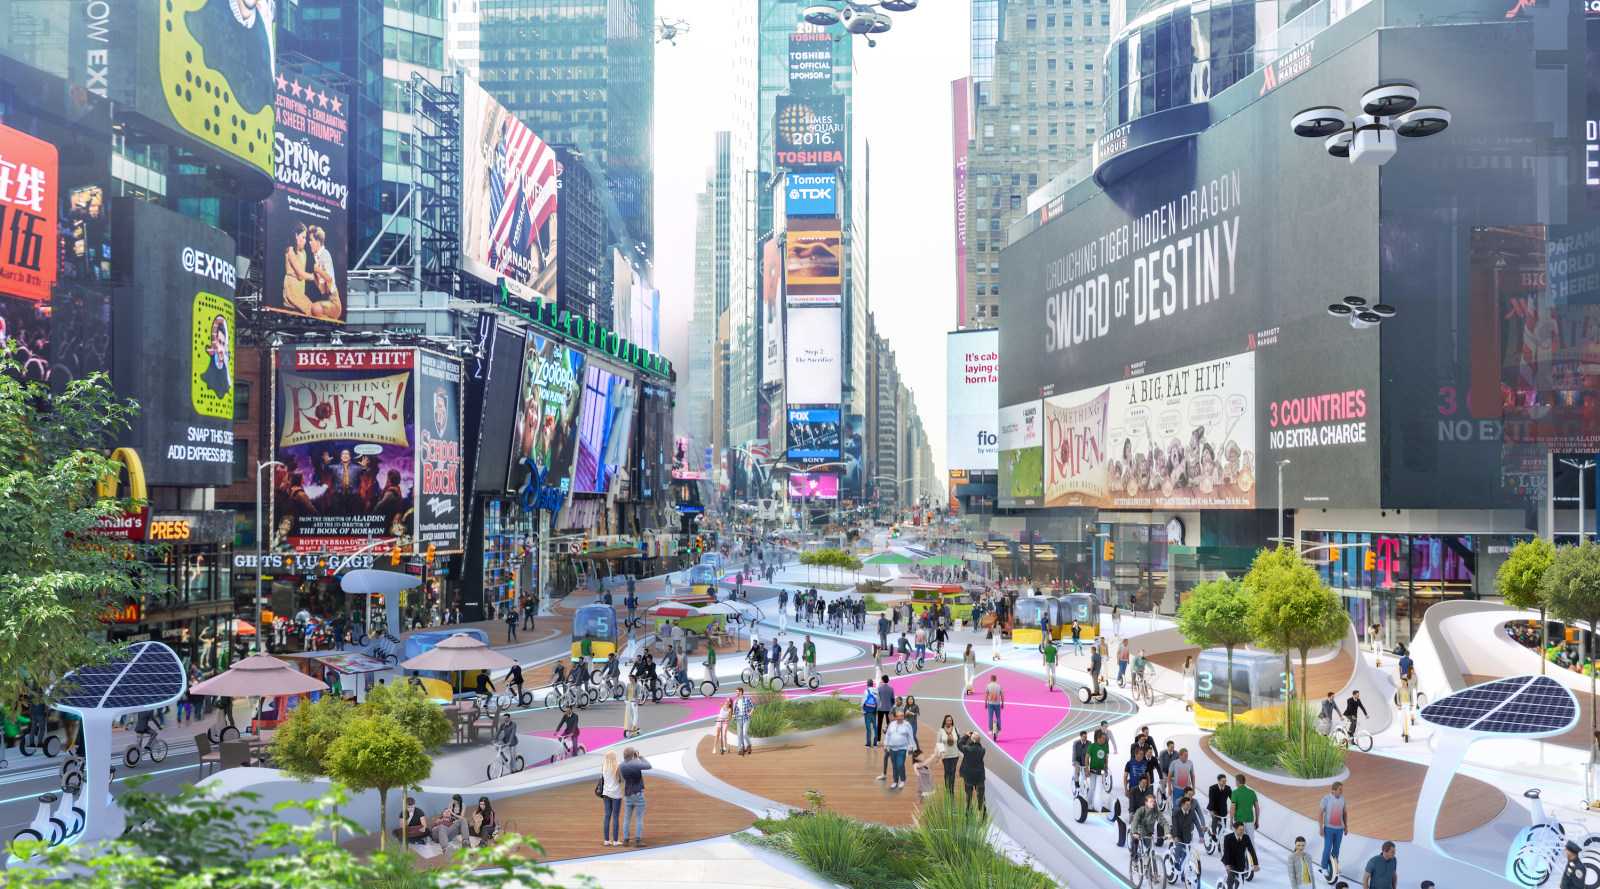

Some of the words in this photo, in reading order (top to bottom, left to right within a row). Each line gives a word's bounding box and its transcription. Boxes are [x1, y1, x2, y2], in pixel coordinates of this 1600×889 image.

[1279, 40, 1314, 67] MARRIOTT
[1278, 54, 1311, 81] MARQUIS
[275, 94, 307, 117] ECTRIFYING
[276, 107, 281, 123] A
[282, 110, 306, 132] SHEER
[803, 116, 832, 124] TIMES
[275, 132, 331, 177] SPRING
[777, 151, 843, 163] TOSHIBA
[798, 188, 832, 199] TDK
[1046, 241, 1097, 292] CROUCHING
[1099, 225, 1129, 267] TIGER
[1133, 201, 1176, 252] HIDDEN
[1181, 168, 1241, 231] DRAGON
[1045, 273, 1110, 353] SWORD
[1114, 277, 1130, 318] OF
[1134, 216, 1240, 325] DESTINY
[1257, 327, 1279, 338] MARRIOTT
[298, 352, 330, 366] BIG,
[335, 352, 366, 365] FAT
[965, 353, 979, 362] It's
[965, 363, 993, 374] laying
[299, 380, 390, 393] SOMETHING
[965, 375, 986, 383] horn
[1166, 369, 1189, 398] FAT
[789, 411, 810, 421] FOX
[1053, 401, 1100, 423] SOMETHING
[1269, 402, 1279, 427] 3
[1281, 389, 1366, 426] COUNTRIES
[187, 426, 210, 442] SNAP
[1270, 430, 1284, 449] NO
[1286, 426, 1318, 448] EXTRA
[1320, 422, 1366, 445] CHARGE
[1438, 420, 1473, 441] NO
[167, 444, 186, 459] ADD
[187, 446, 219, 462] EXPRESS
[420, 429, 460, 463] SCHOOL
[423, 462, 457, 495] ROCK
[150, 521, 190, 539] PRESS
[1078, 604, 1087, 618] 3
[597, 616, 609, 632] 5
[1198, 671, 1213, 691] 3
[1198, 691, 1211, 699] line
